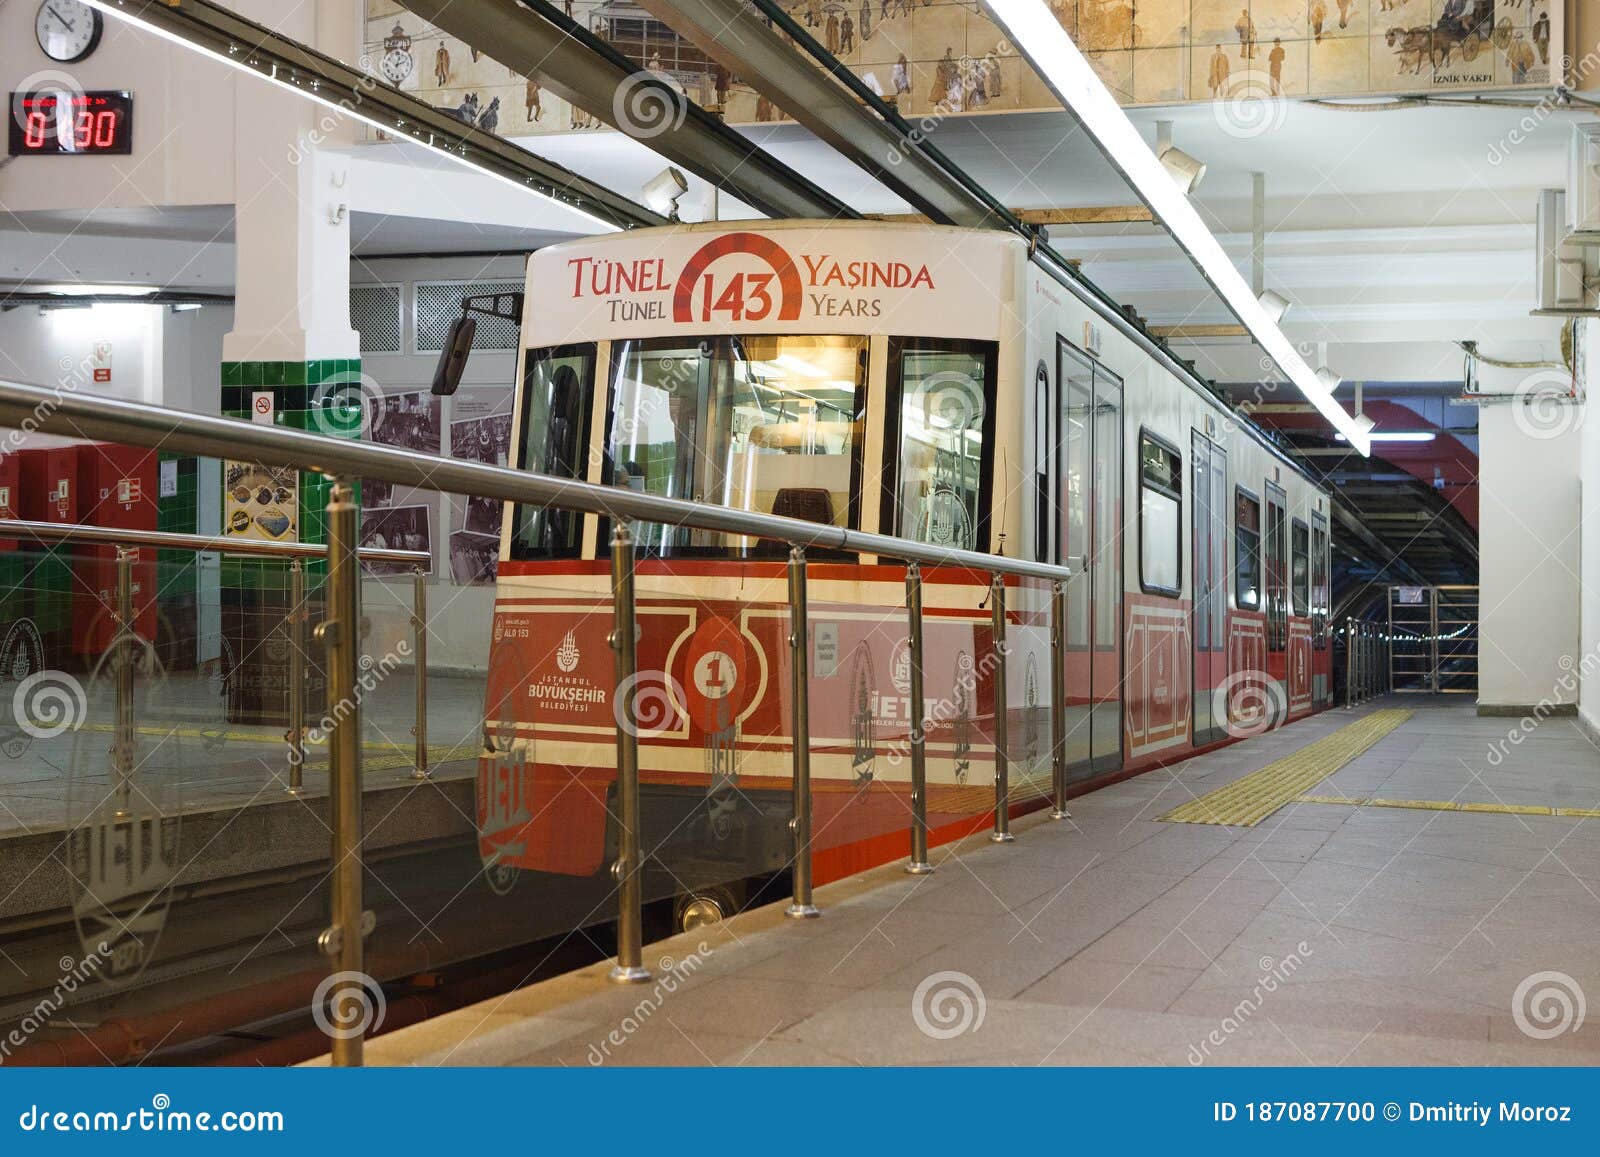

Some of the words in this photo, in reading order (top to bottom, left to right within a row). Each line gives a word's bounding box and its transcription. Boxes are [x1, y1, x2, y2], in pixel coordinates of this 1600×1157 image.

[567, 258, 672, 298] TÜNEL
[702, 273, 776, 322] 143
[801, 254, 935, 290] YAŞINDA
[607, 299, 667, 322] TÜNEL
[808, 293, 882, 318] YEARS
[543, 673, 591, 686] İSTANBUL
[706, 659, 724, 687] 1
[528, 681, 606, 704] BÜYÜKŞEHİR
[540, 701, 589, 712] BELEDİYESİ
